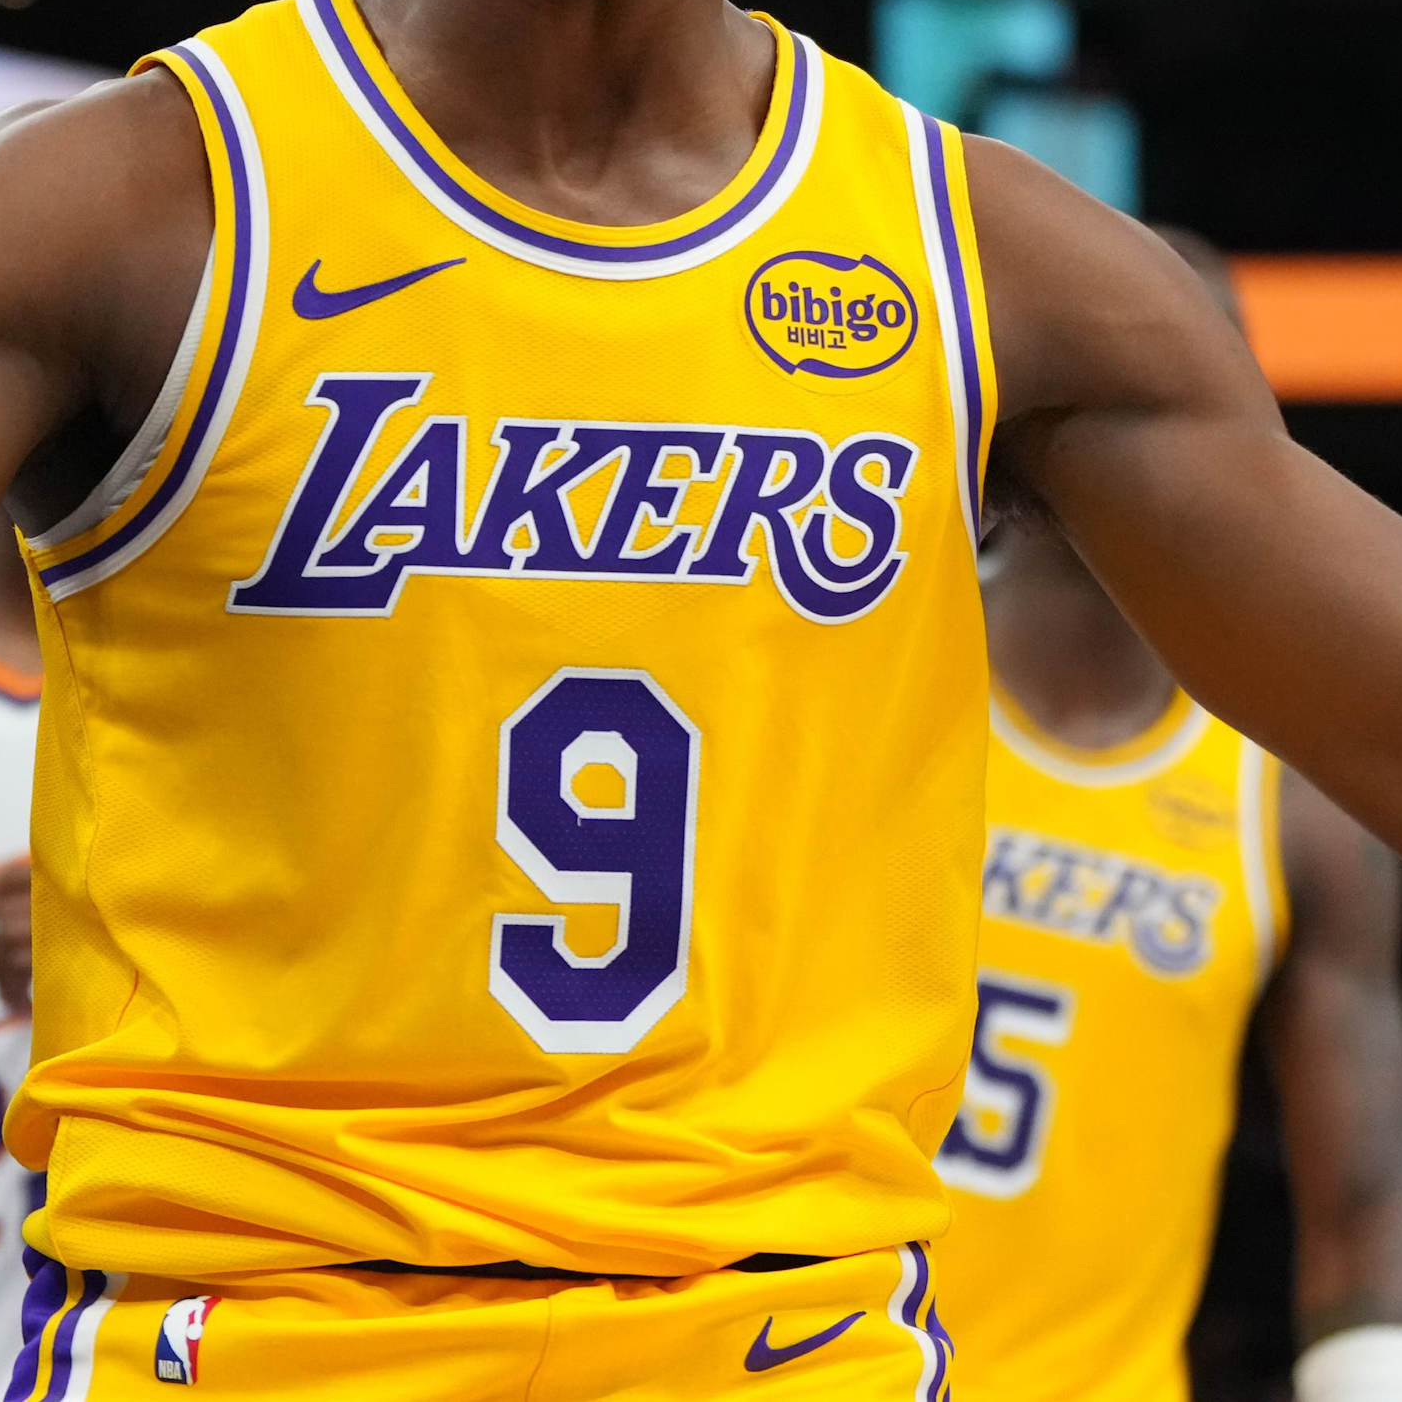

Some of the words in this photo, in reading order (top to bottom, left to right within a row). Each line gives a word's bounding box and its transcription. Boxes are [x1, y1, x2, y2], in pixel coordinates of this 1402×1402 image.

[760, 281, 907, 342] bibigo
[787, 325, 848, 350] 비비고
[226, 371, 920, 625] LAKERS
[488, 666, 703, 1054] 9
[932, 966, 1077, 1200] 5
[158, 1358, 183, 1381] NBA
